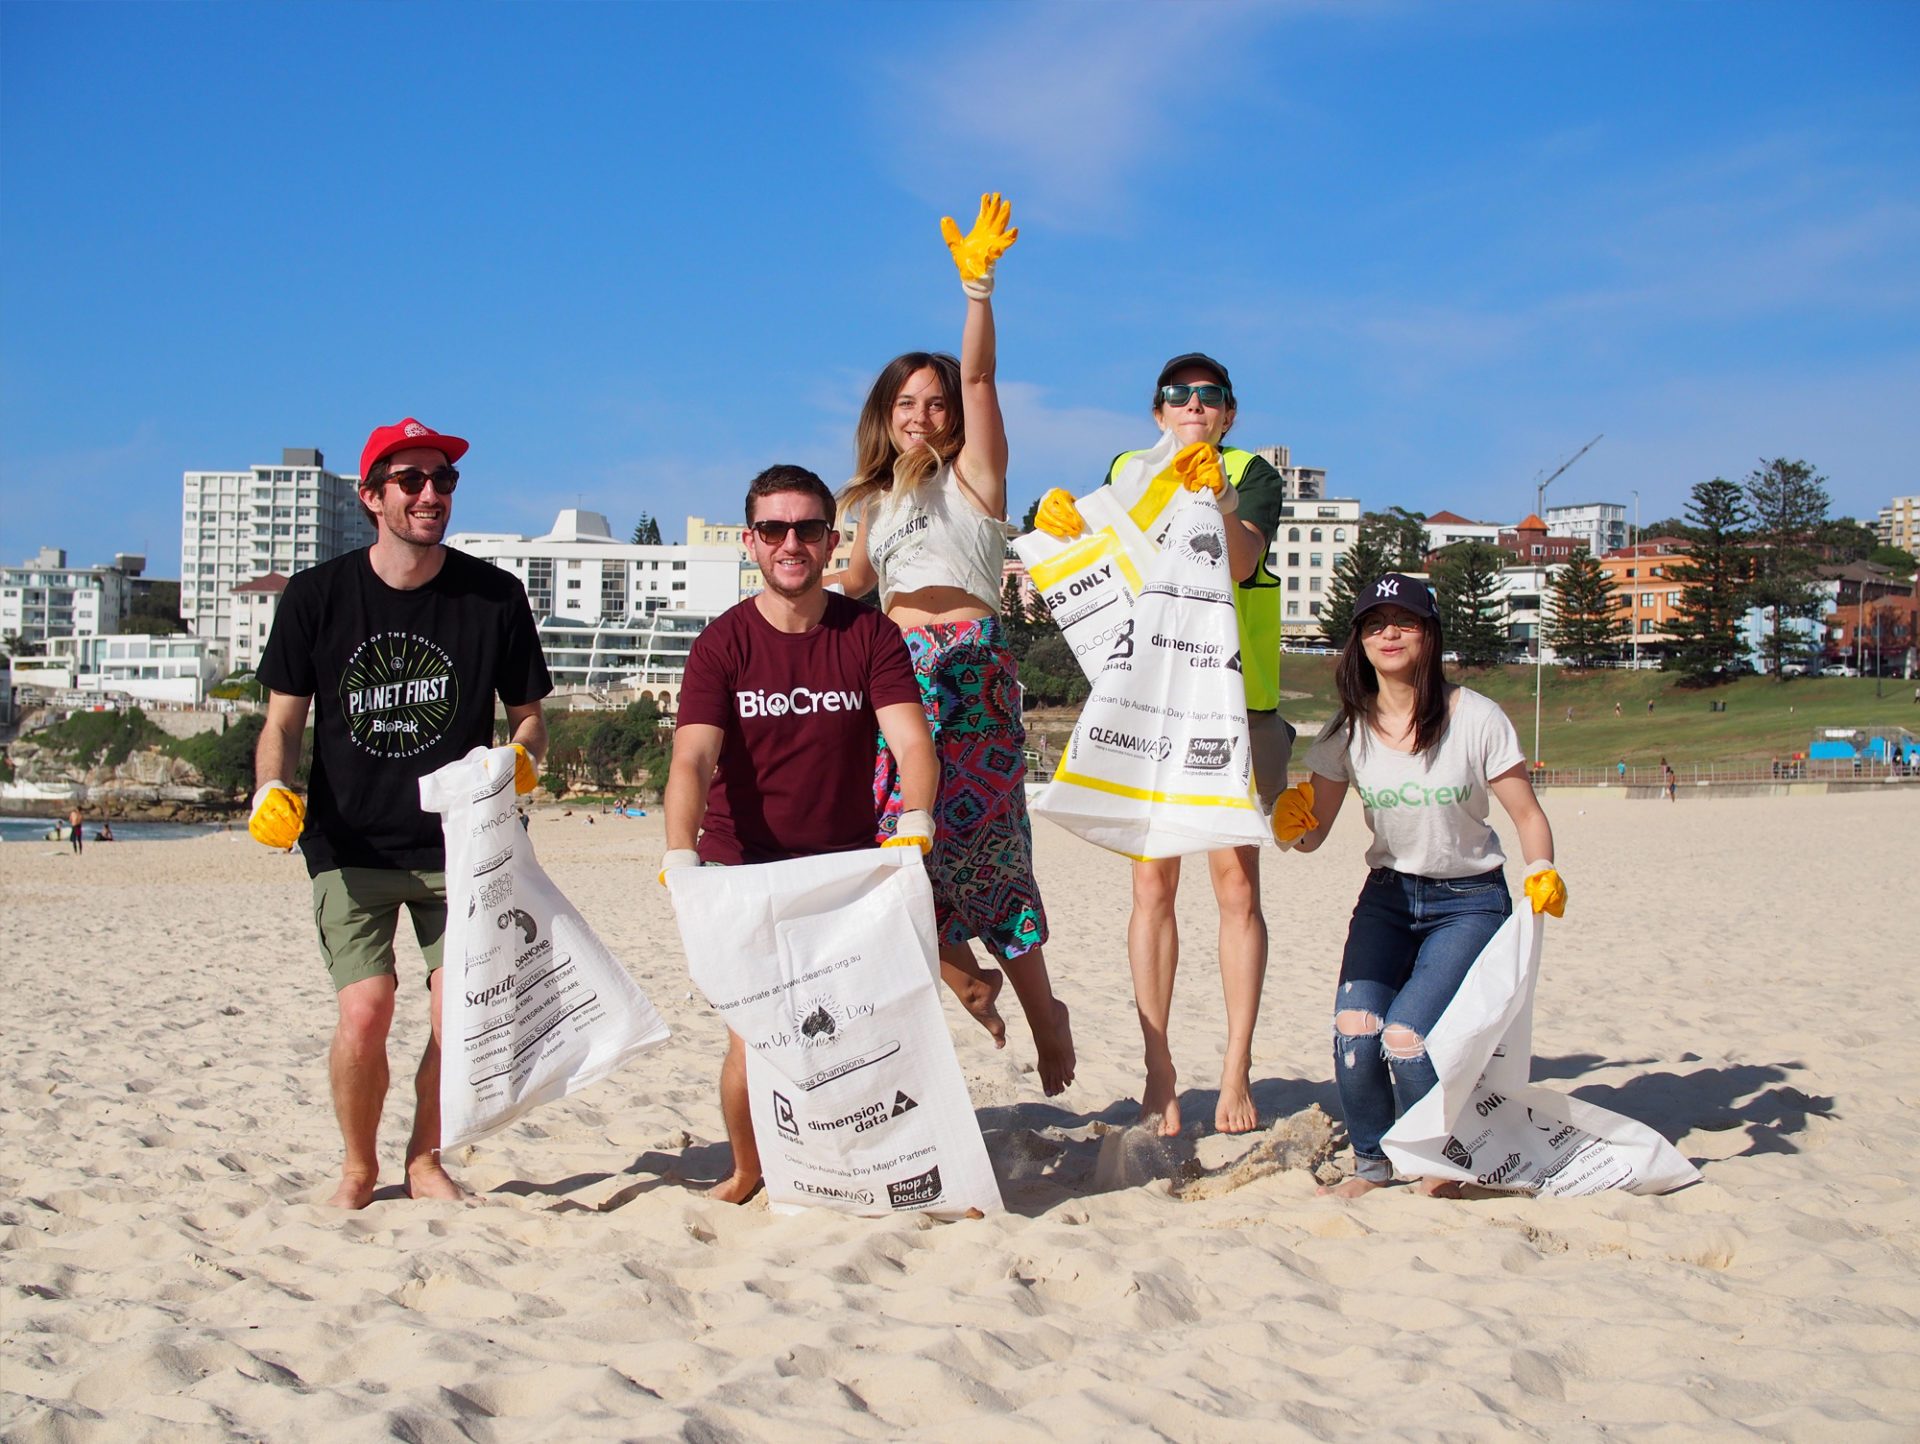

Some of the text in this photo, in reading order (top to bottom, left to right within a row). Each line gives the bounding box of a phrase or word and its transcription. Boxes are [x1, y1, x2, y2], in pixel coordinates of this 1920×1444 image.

[896, 515, 928, 541] PLASTIC
[1069, 564, 1112, 597] ONLY
[1181, 585, 1232, 602] Champions
[1060, 601, 1099, 626] Supporter
[349, 631, 453, 667] PART OF THE SOLUTION
[1151, 633, 1224, 655] dimension
[1189, 655, 1221, 668] data
[349, 676, 449, 715] PLANET FIRST
[736, 687, 863, 718] BioCrew
[1091, 694, 1118, 705] Clean
[1119, 697, 1131, 708] Up
[1167, 707, 1185, 720] Day
[373, 720, 419, 733] BioPak
[365, 746, 383, 757] THE
[387, 734, 442, 758] POLLUTION
[1089, 726, 1169, 757] CLEANAWAY
[1192, 739, 1228, 753] Shop A
[1187, 753, 1224, 765] Docket
[741, 990, 770, 1005] donate
[782, 954, 862, 989] www.cleanup.org.au
[543, 980, 581, 1007] HEALTHCARE
[483, 1017, 503, 1030] Gold
[534, 1004, 575, 1035] Supporters
[771, 1032, 792, 1048] Up
[845, 1003, 875, 1020] Day
[478, 1029, 511, 1047] AUSTRALIA
[471, 1046, 508, 1065] YOKOHAMA
[816, 1057, 866, 1083] Champions
[807, 1101, 885, 1132] dimension
[854, 1113, 889, 1133] data
[852, 1167, 871, 1176] Day
[872, 1159, 898, 1171] Major
[898, 1144, 937, 1163] Partners
[1477, 1152, 1521, 1186] Saputo
[793, 1180, 868, 1203] CLEANAWAY
[892, 1173, 934, 1193] Shop A
[893, 1186, 933, 1203] Docket
